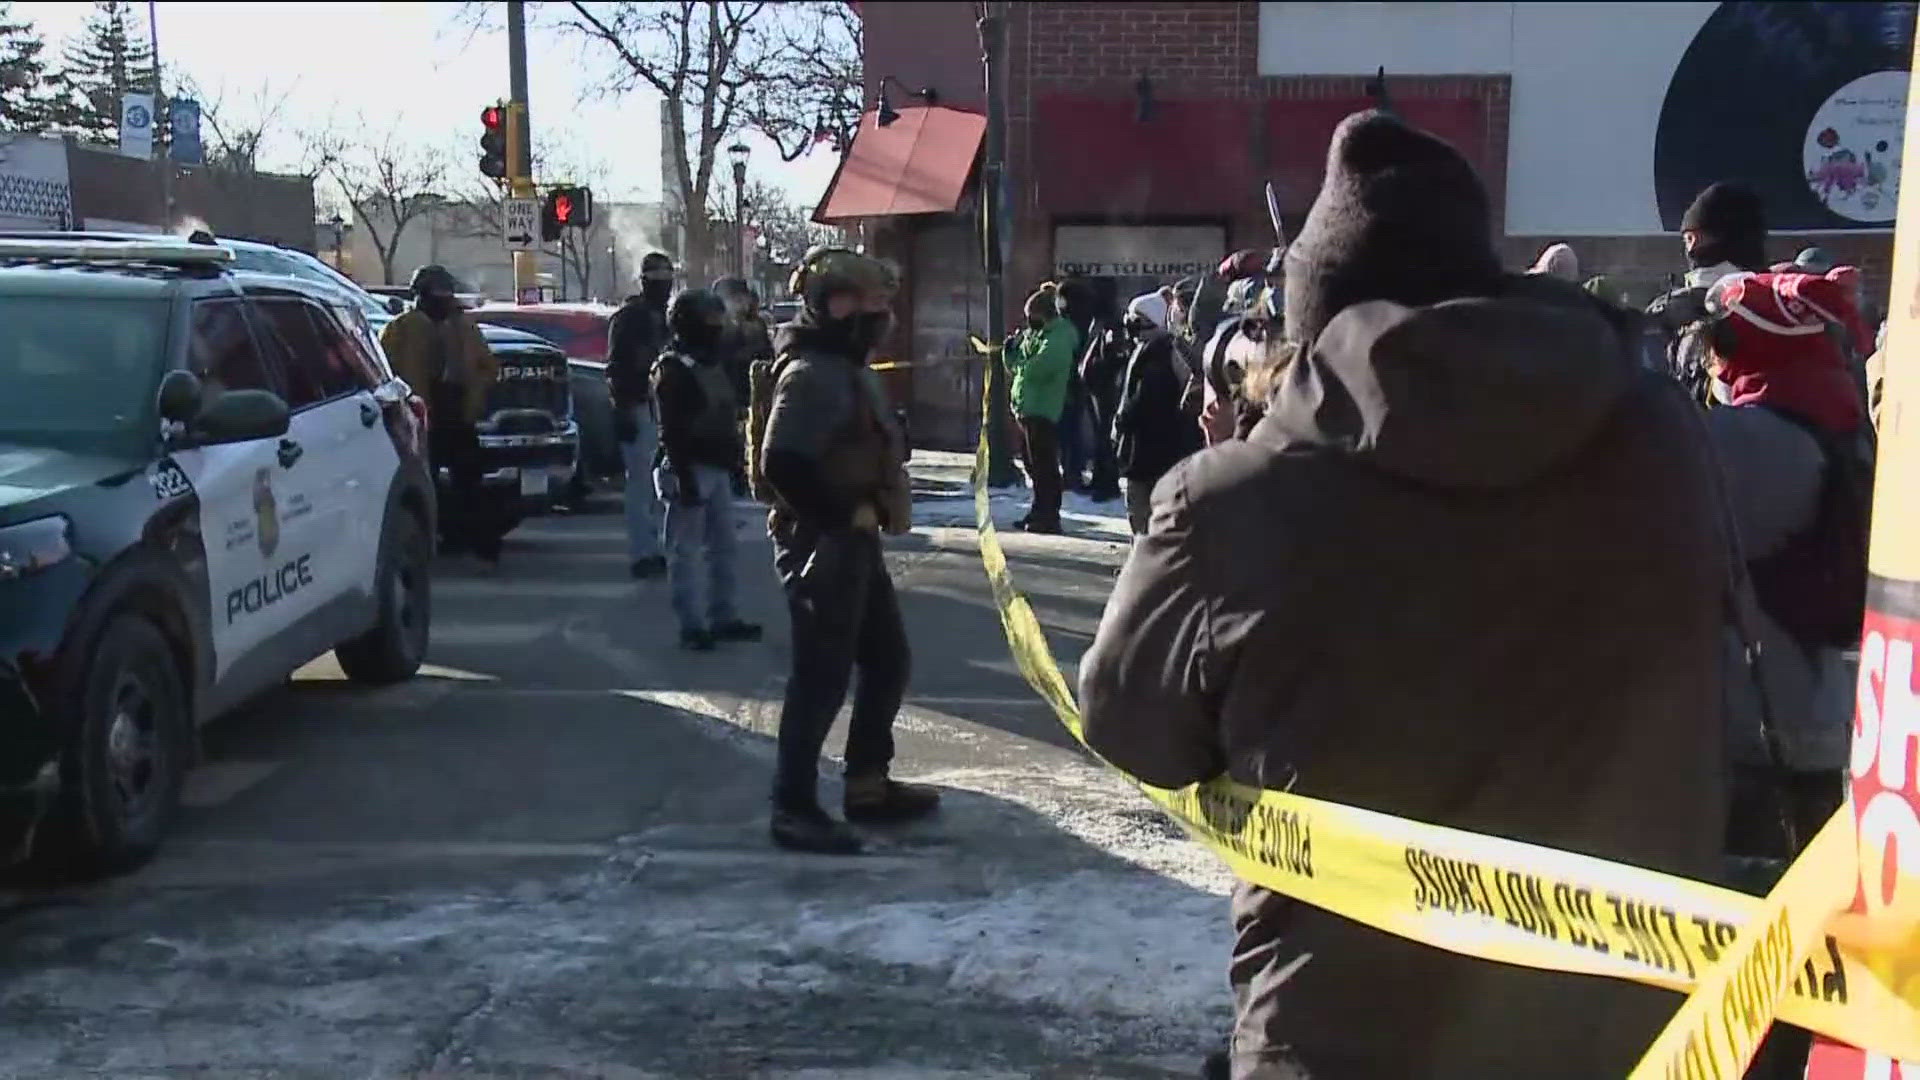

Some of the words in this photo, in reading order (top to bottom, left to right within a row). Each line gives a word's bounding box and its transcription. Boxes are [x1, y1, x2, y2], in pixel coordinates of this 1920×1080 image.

[509, 202, 533, 214] ONE
[509, 217, 535, 230] WAY
[1112, 262, 1138, 274] TO
[226, 553, 313, 625] POLICE
[1257, 803, 1314, 879] POLICE
[1405, 846, 1495, 920] CROSS
[1494, 867, 1558, 940] NOT
[1607, 895, 1697, 980] LINE
